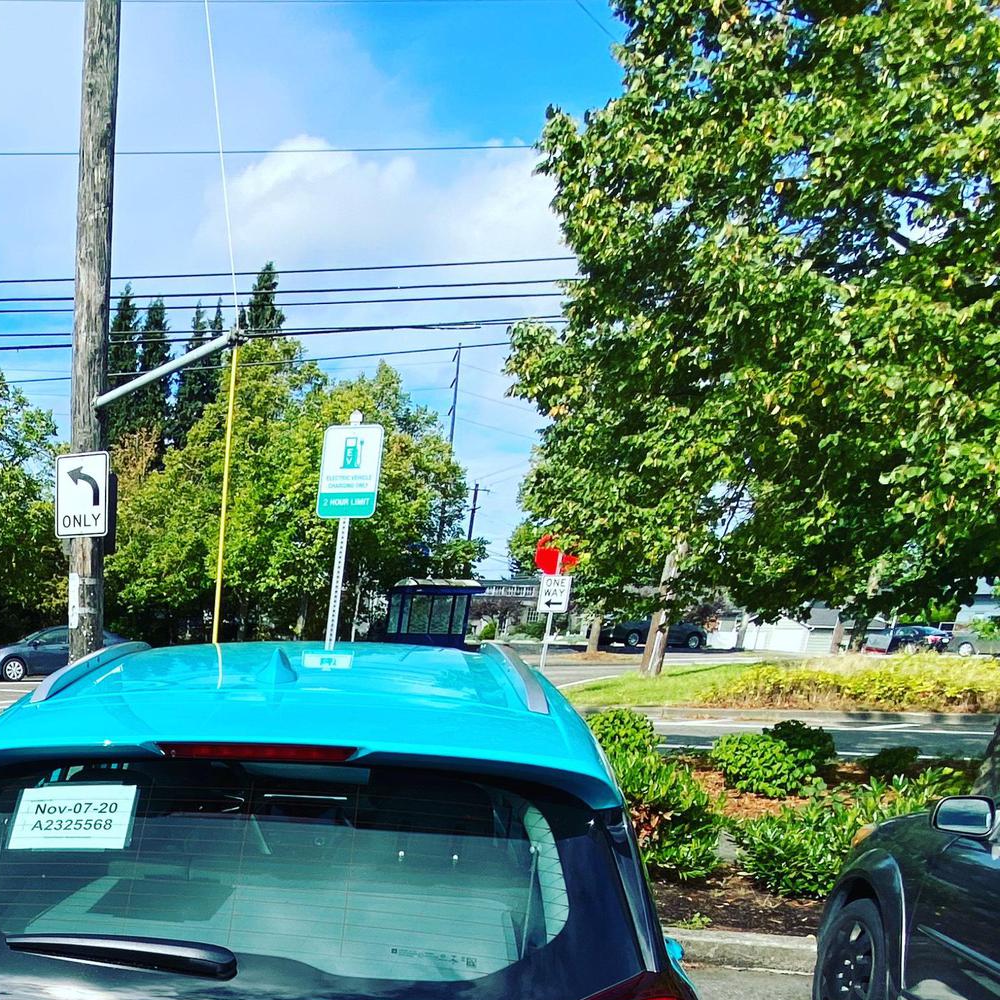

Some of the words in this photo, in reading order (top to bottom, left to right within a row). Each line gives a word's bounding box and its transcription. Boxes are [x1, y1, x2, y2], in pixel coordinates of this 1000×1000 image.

[322, 498, 329, 507] 2
[329, 498, 349, 506] HOUR
[350, 497, 370, 506] LIMIT
[62, 513, 101, 529] ONLY
[545, 578, 566, 587] ONE
[544, 588, 565, 597] WAY
[34, 802, 118, 815] Nov-07-20
[31, 818, 113, 831] A2325568
